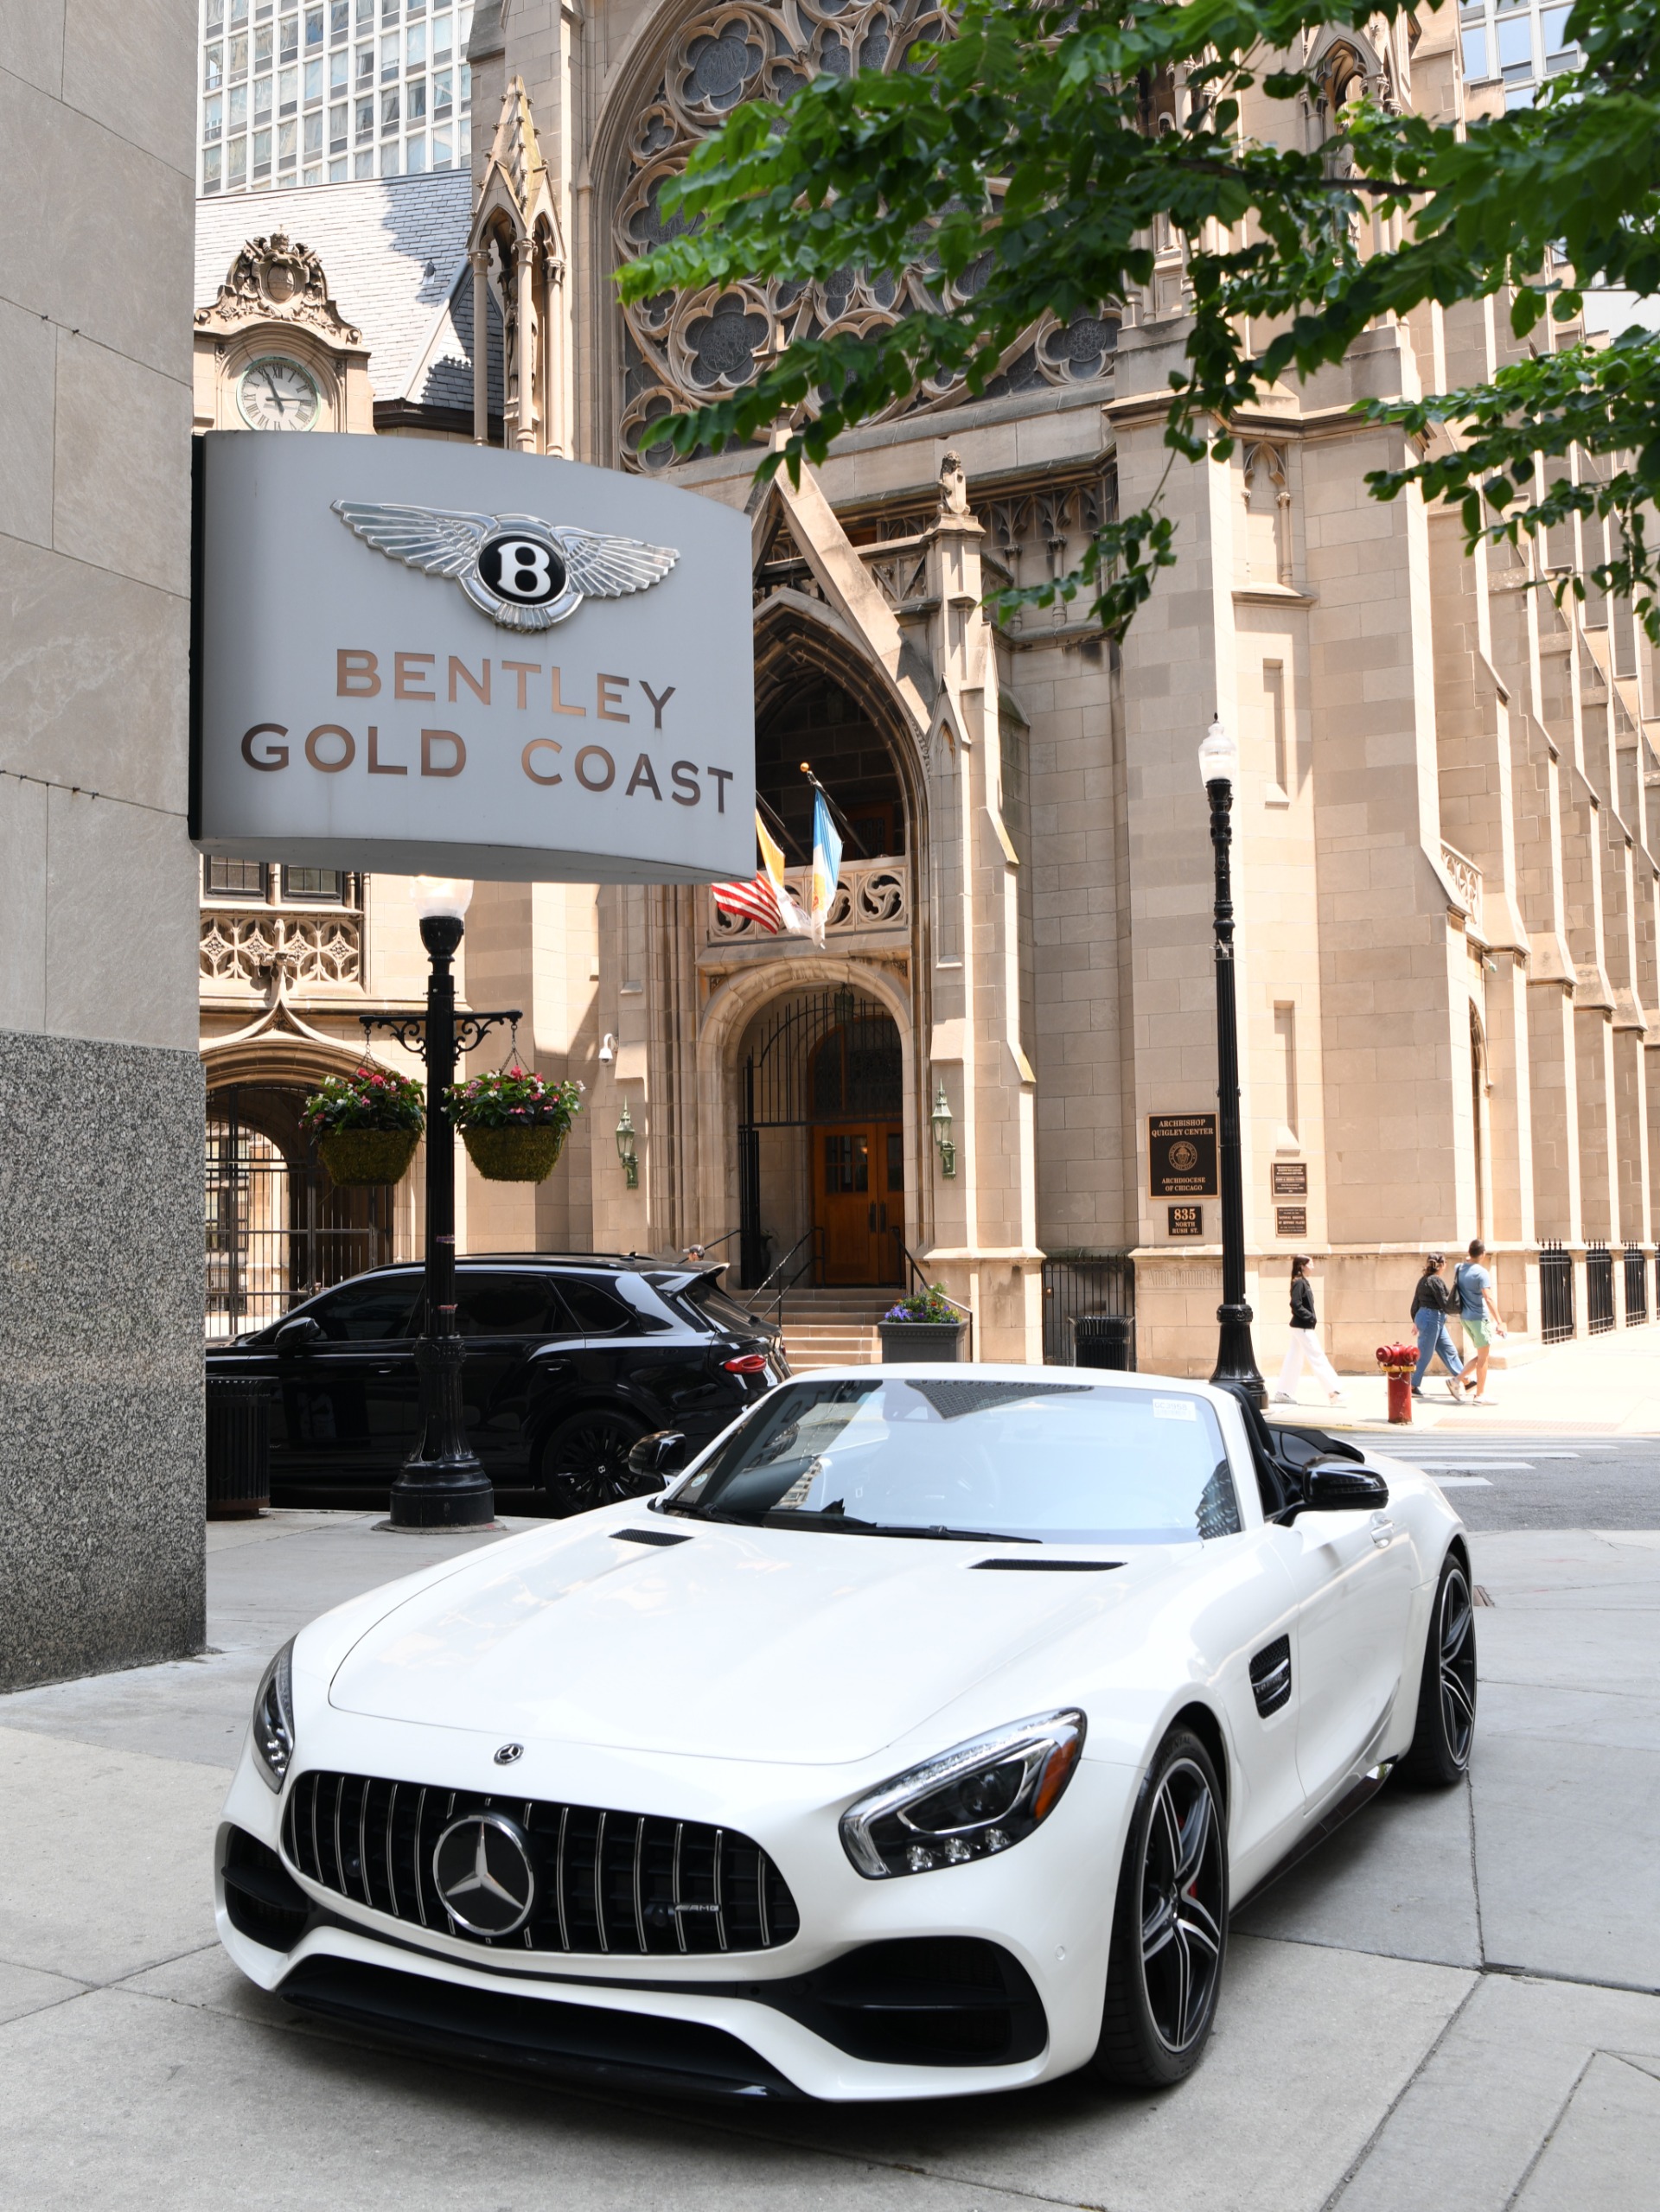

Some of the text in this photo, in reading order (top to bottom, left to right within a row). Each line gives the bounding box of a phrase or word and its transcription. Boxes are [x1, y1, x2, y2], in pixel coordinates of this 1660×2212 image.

[497, 541, 551, 598] B
[335, 648, 676, 730] BENTLEY
[240, 723, 733, 813] GOLD COAST
[1159, 1119, 1206, 1127] ARCHBISHOP
[1173, 1208, 1196, 1220] 835
